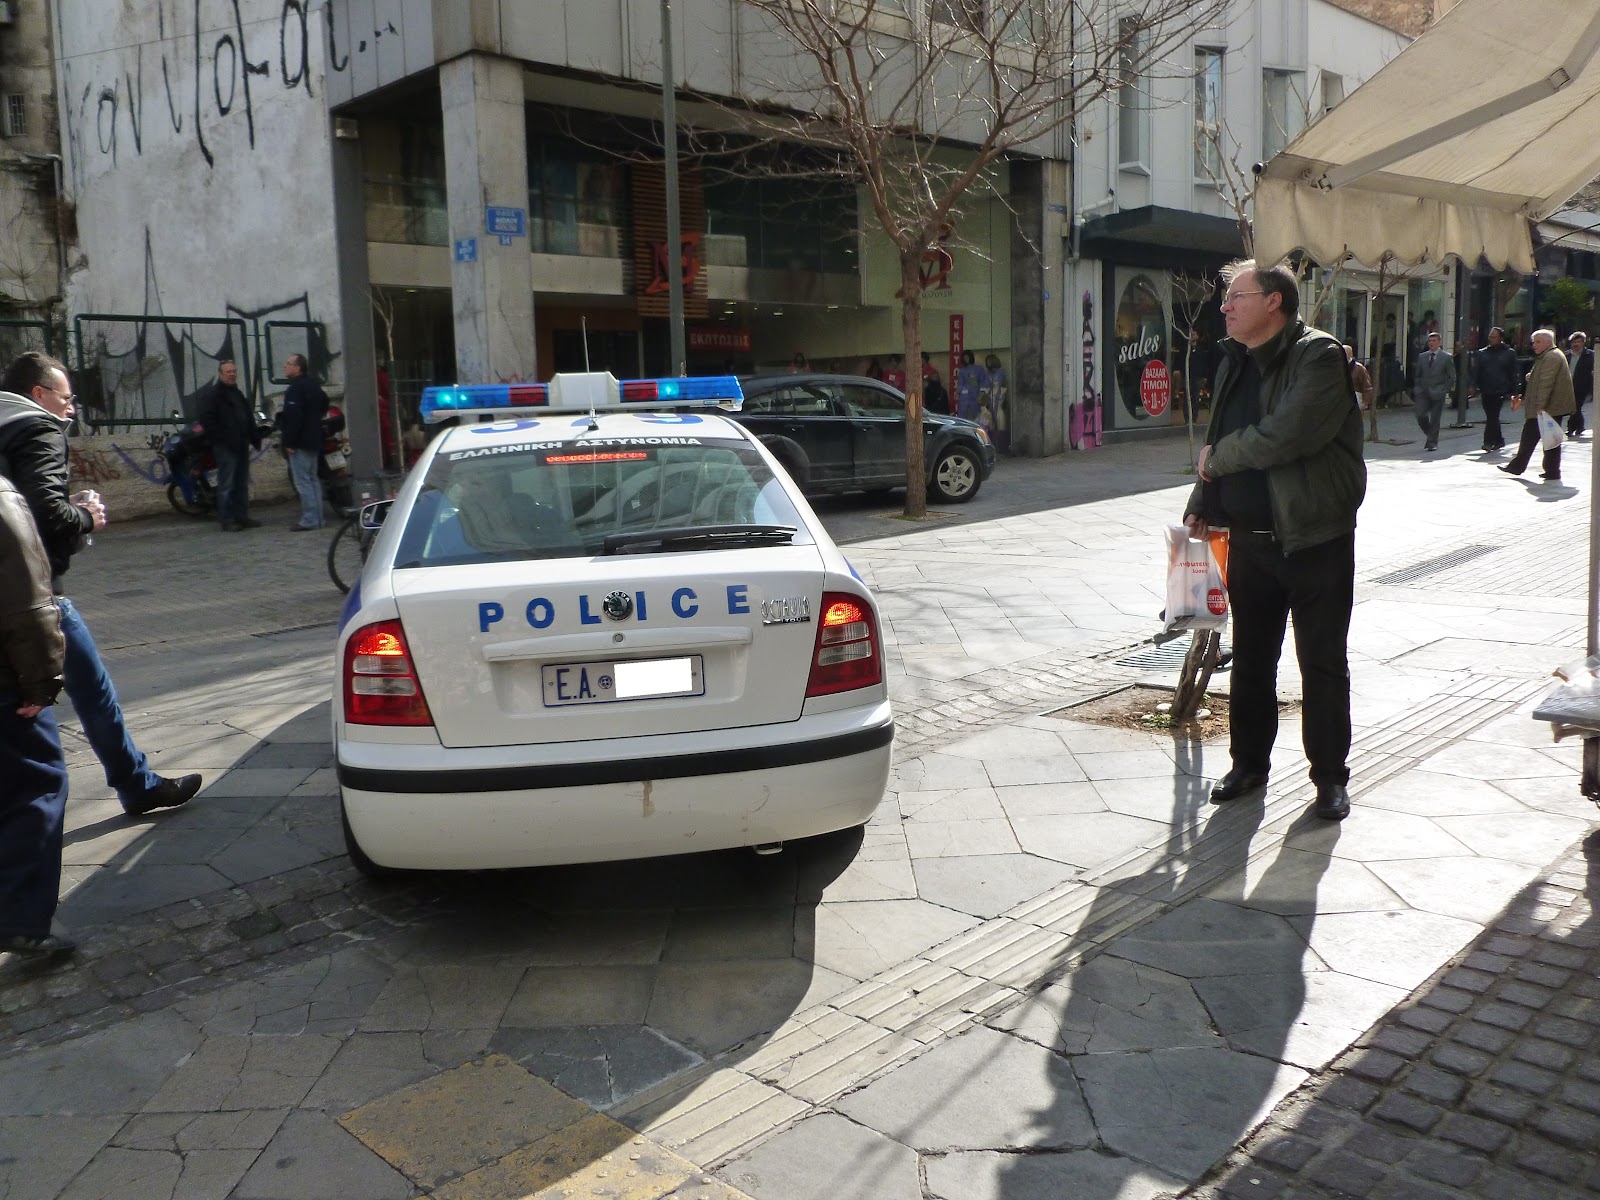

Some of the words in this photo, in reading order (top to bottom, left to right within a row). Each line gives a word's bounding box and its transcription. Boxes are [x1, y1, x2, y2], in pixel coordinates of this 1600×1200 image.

[1118, 325, 1160, 363] sales
[1146, 368, 1166, 378] BAZAAR
[1143, 380, 1168, 390] ΤΙΜΩΝ
[449, 441, 563, 461] ΕΛΛΗΝΙΚΗ
[575, 437, 702, 447] ΑΣΤΥΝΟΜΙΑ
[478, 584, 750, 632] POLICE
[761, 596, 811, 618] OCTAVIA
